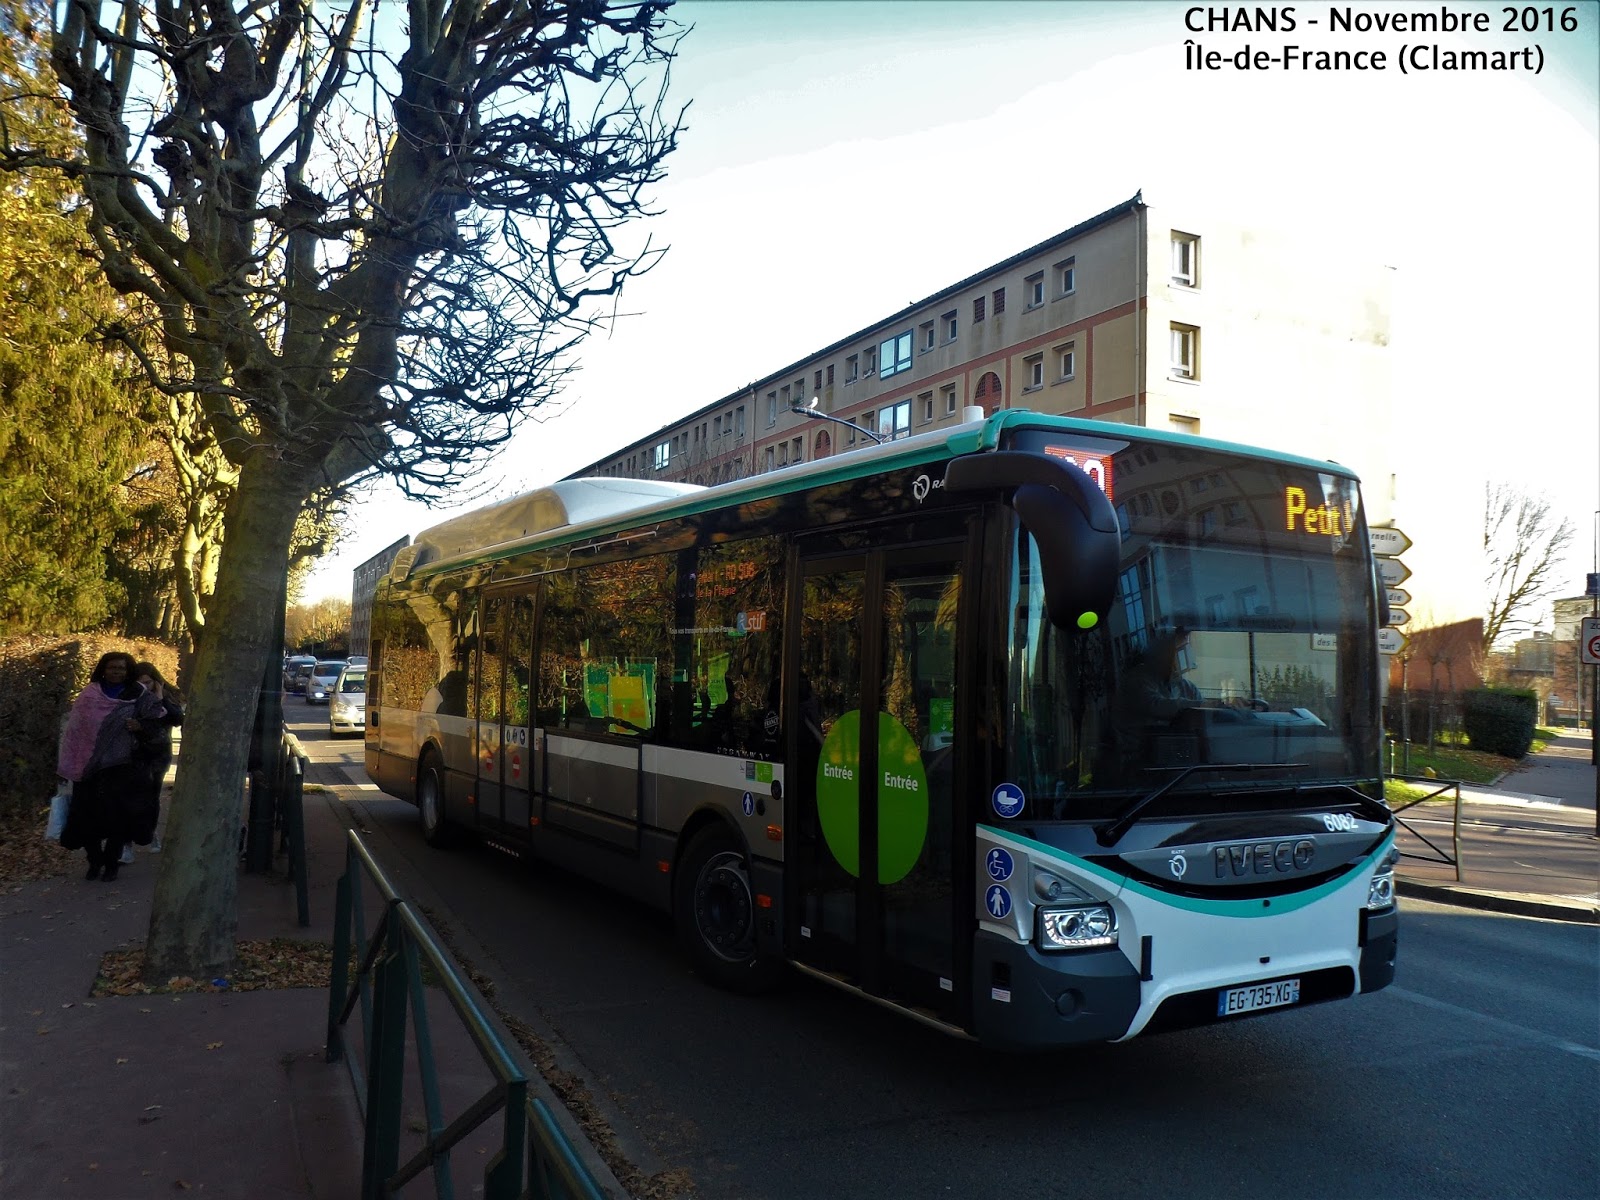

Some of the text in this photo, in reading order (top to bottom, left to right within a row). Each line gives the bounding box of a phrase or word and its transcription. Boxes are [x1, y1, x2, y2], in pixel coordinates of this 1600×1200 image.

[932, 479, 945, 489] RA
[1285, 486, 1342, 536] Petit
[824, 762, 853, 781] Entrée
[884, 771, 918, 792] Entrée
[1322, 812, 1360, 832] 6082
[1214, 840, 1316, 879] IVECO
[1228, 982, 1291, 1012] EG-735-XG
